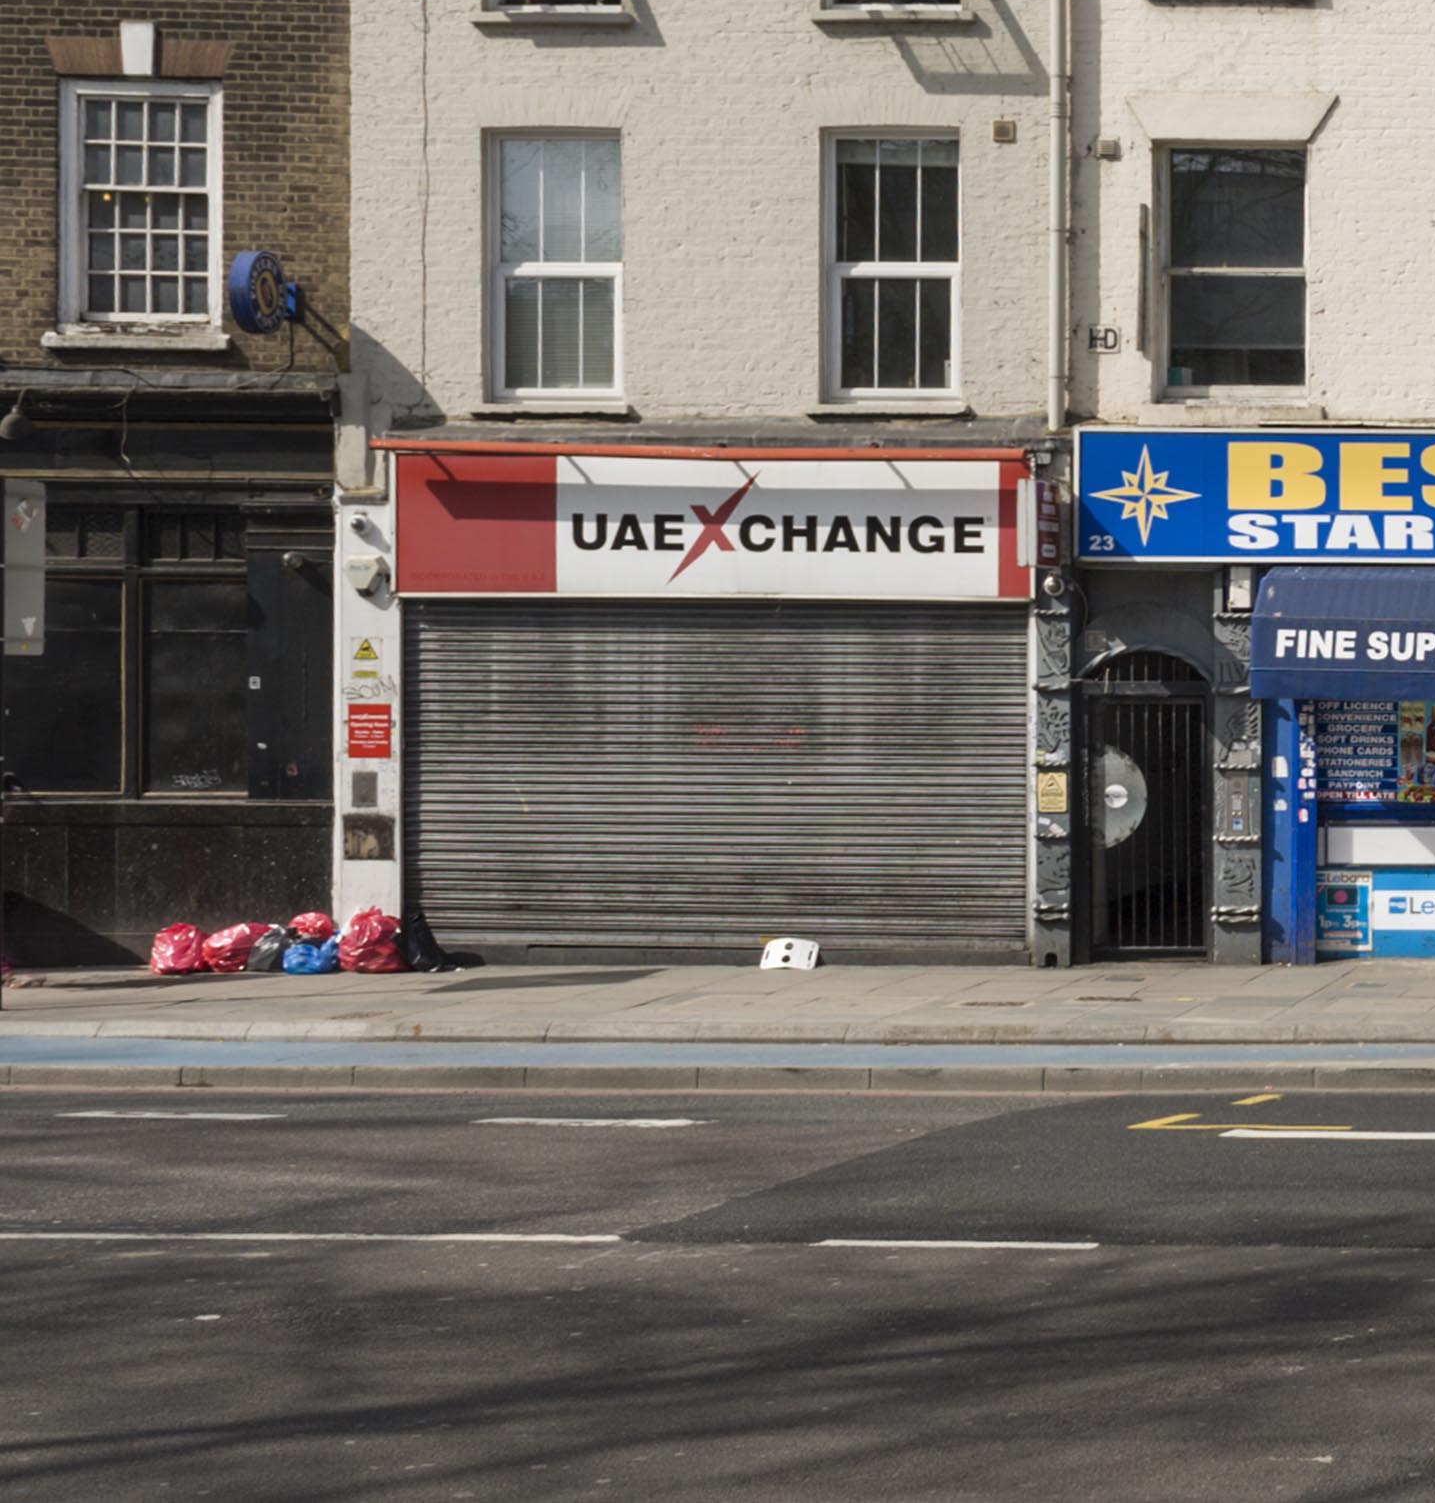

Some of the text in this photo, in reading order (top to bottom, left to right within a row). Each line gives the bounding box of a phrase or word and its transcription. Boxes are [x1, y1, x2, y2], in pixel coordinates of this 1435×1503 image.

[1227, 513, 1434, 550] STAR
[1089, 535, 1115, 551] 23
[1275, 629, 1357, 659] FINE
[1319, 702, 1394, 710] OFF LICENCE
[1318, 713, 1396, 722] CONVENIENCE
[1328, 724, 1383, 732] GROCERY
[1318, 736, 1394, 744] SOFT DRINKS
[1318, 747, 1394, 755] PHONE CARDS
[1319, 758, 1392, 767] STATIONERIES
[1327, 769, 1384, 778] SANDWICH
[1369, 791, 1396, 799] LATE
[1326, 872, 1370, 883] Lebara
